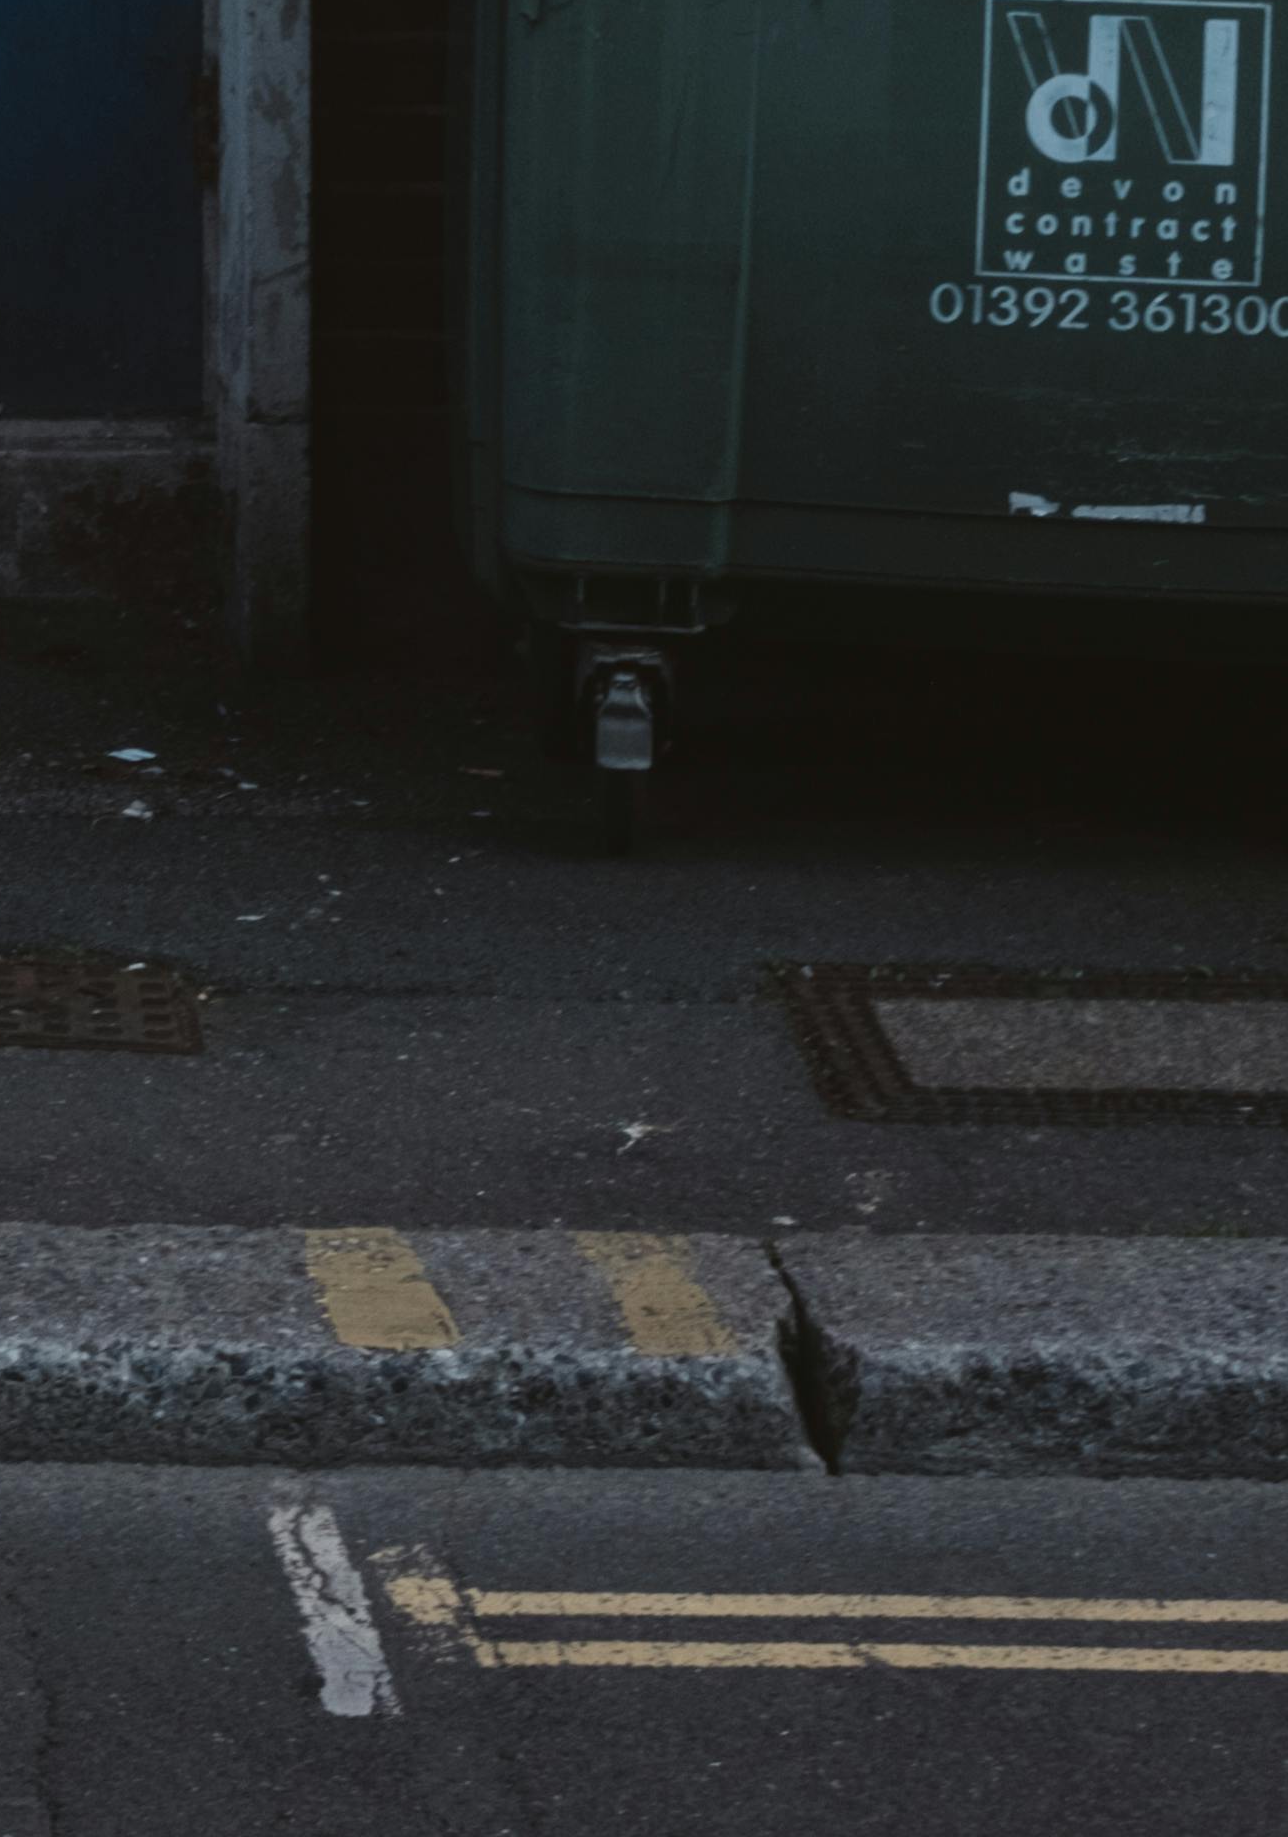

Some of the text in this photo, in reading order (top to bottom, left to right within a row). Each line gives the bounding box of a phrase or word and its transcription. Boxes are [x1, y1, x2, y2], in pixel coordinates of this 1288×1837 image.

[1007, 168, 1237, 205] devon
[1005, 211, 1237, 243] contract
[1004, 247, 1234, 281] waste
[928, 281, 1090, 331] 01392
